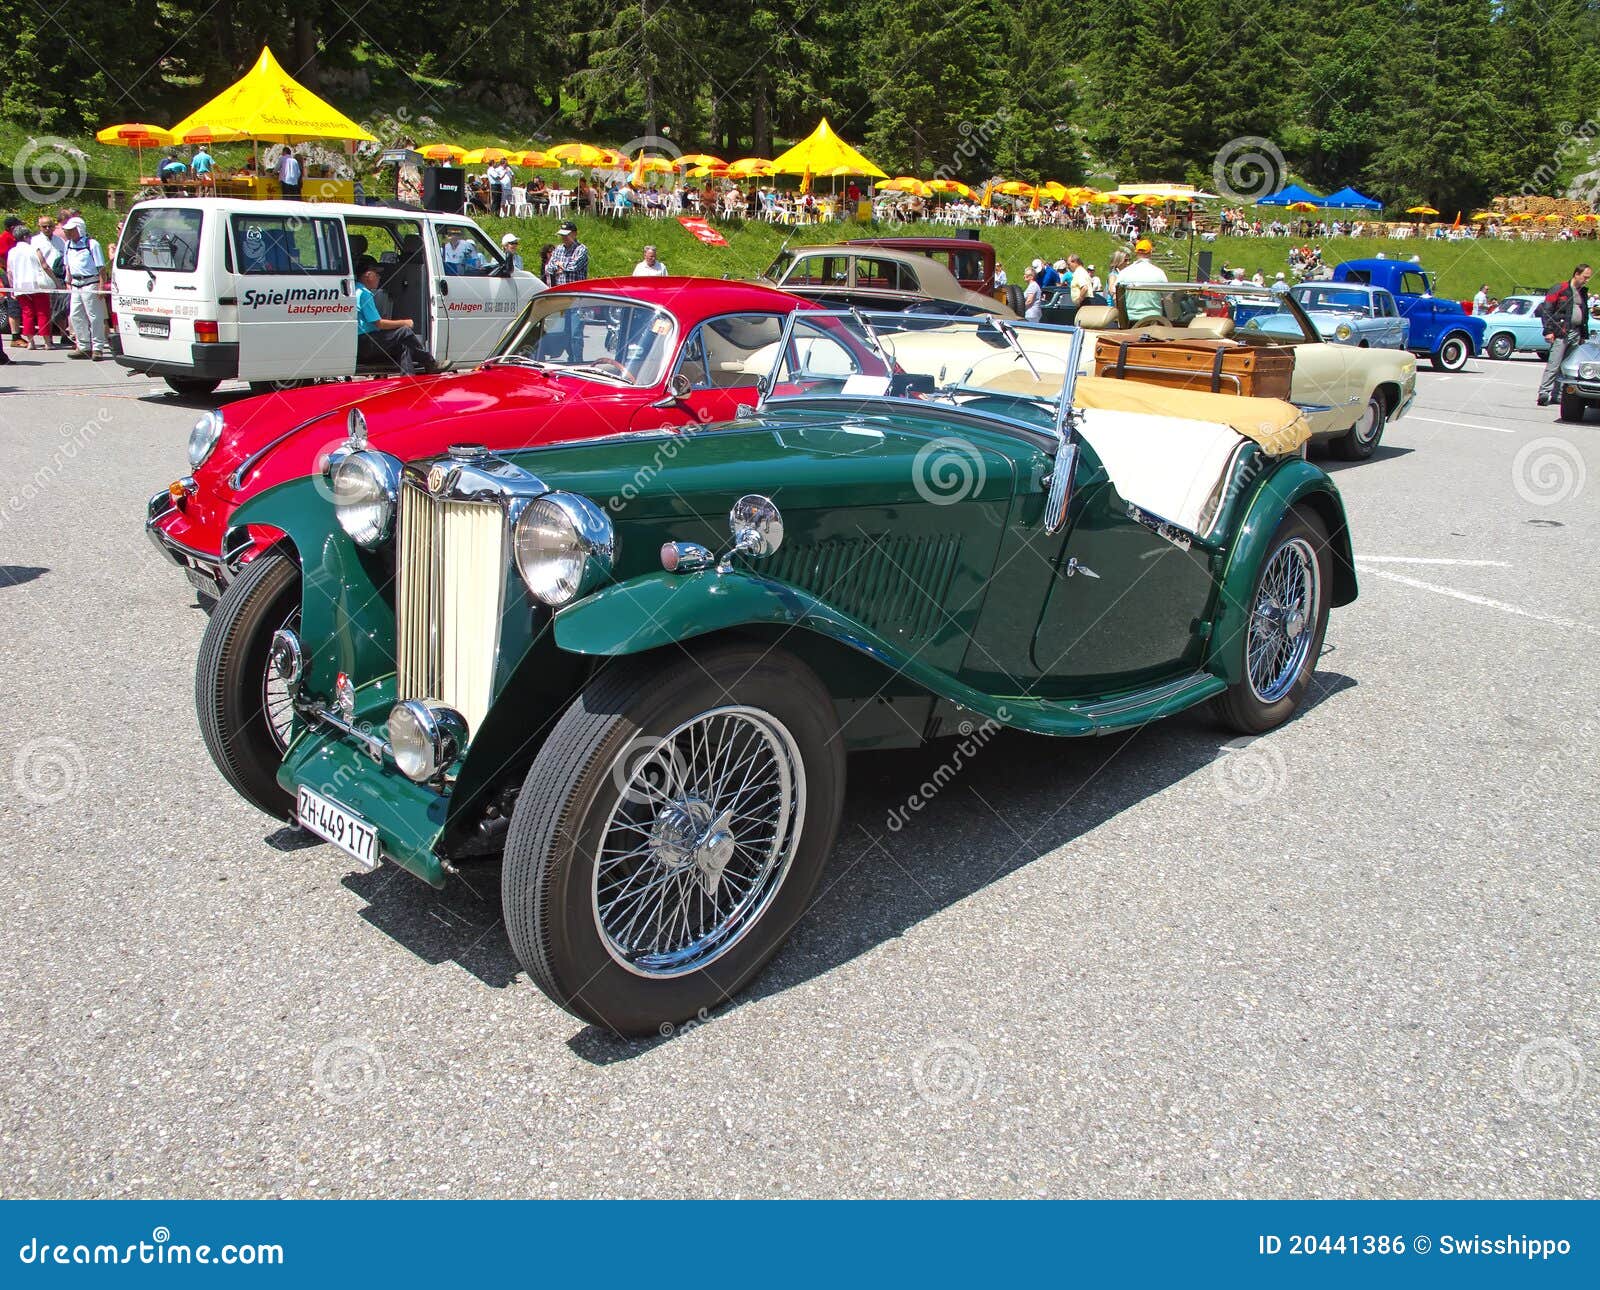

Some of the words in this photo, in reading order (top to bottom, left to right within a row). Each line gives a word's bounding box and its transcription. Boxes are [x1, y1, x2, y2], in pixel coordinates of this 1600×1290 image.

[440, 183, 458, 192] Laney
[119, 296, 149, 308] Spielmann
[242, 288, 340, 309] Spielmann
[287, 303, 355, 315] Lautsprecher
[448, 302, 483, 313] Anlagen
